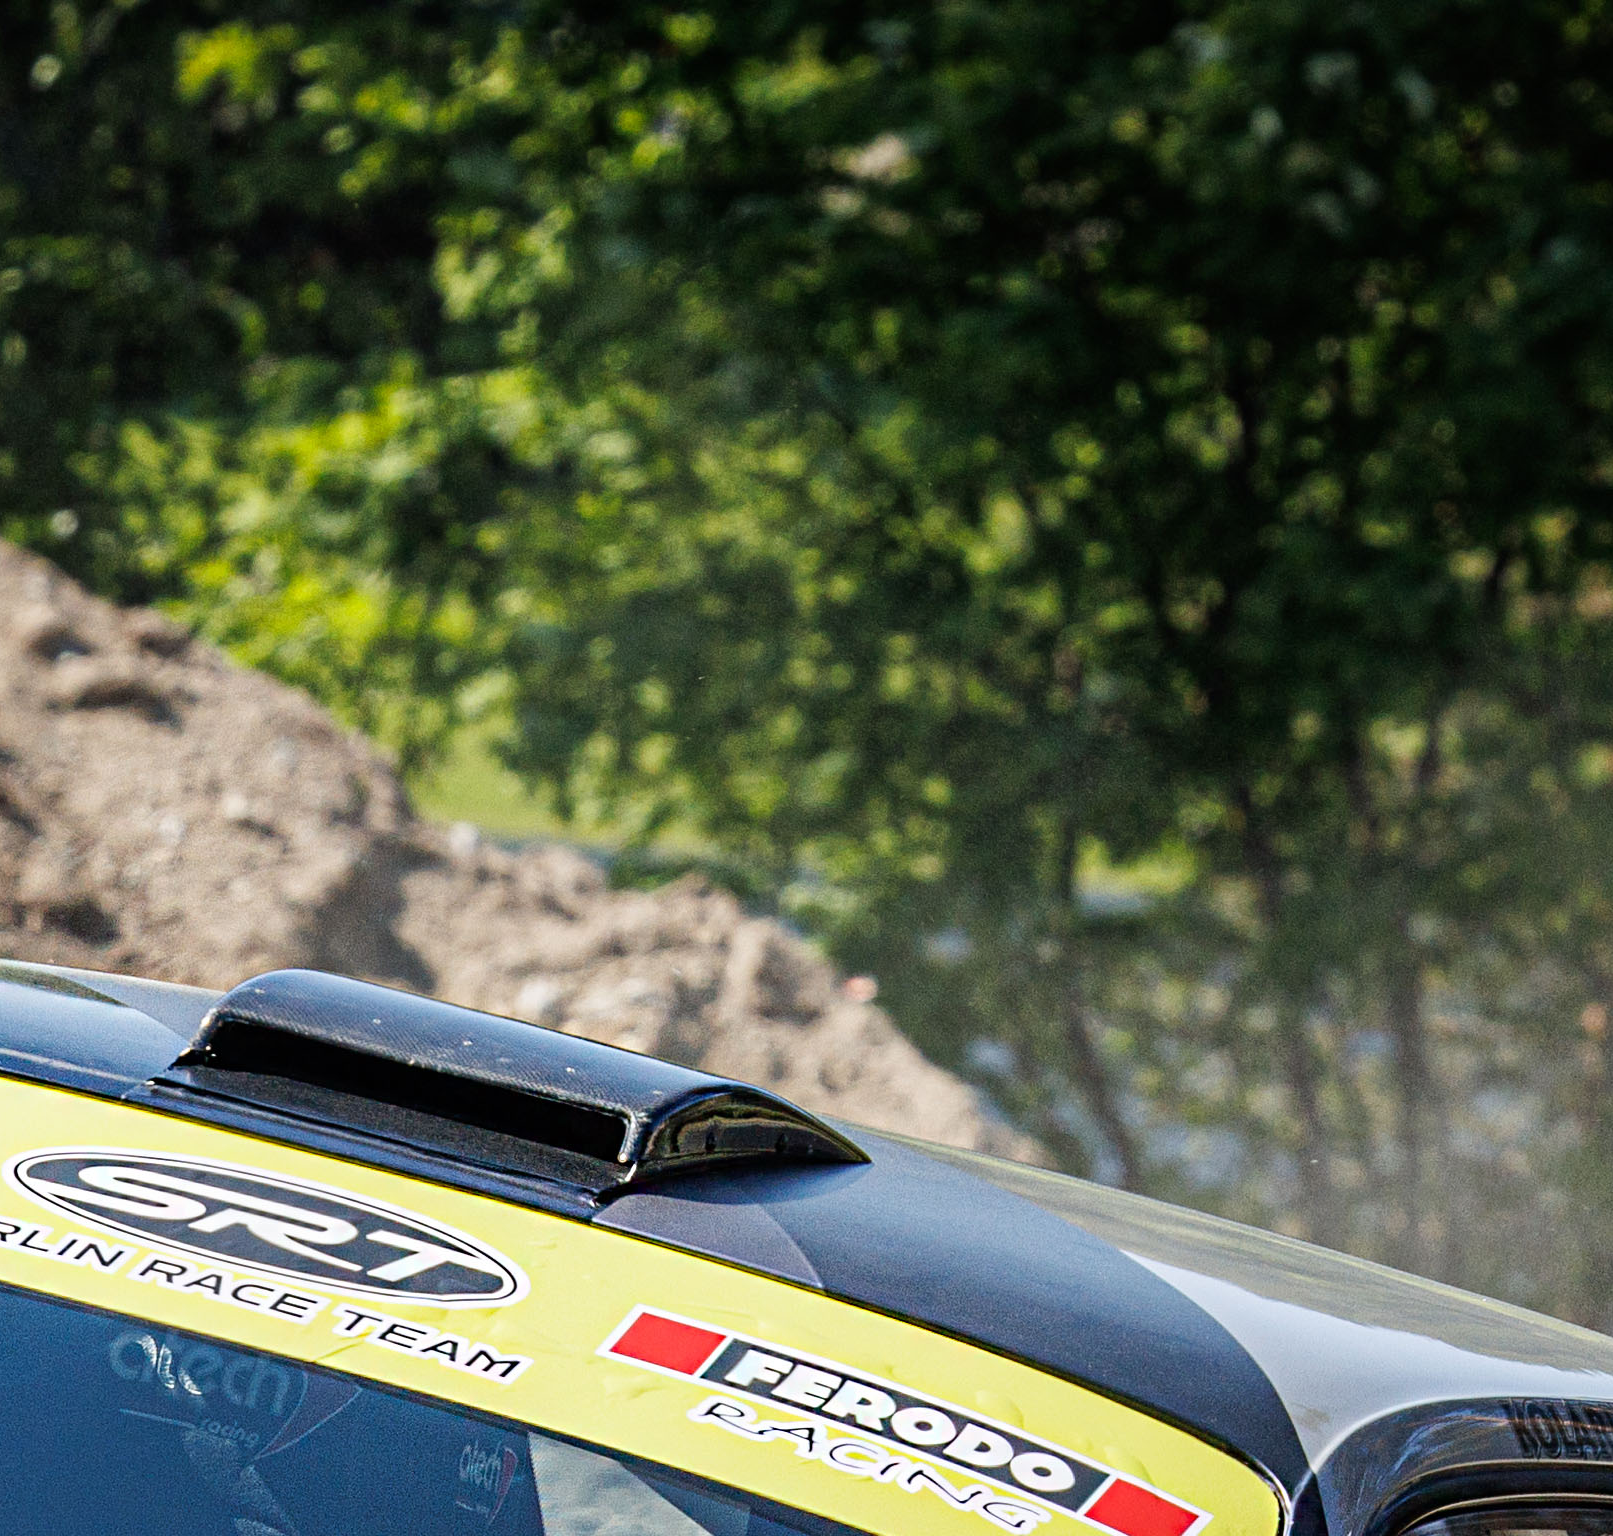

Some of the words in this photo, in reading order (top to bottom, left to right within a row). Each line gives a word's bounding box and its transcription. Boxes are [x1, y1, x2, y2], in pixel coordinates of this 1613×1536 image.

[77, 1163, 490, 1283] SRT
[138, 1258, 315, 1320] RACE
[341, 1308, 521, 1380] TEAM
[696, 1401, 1045, 1531] RACING
[724, 1349, 1076, 1494] FERODO
